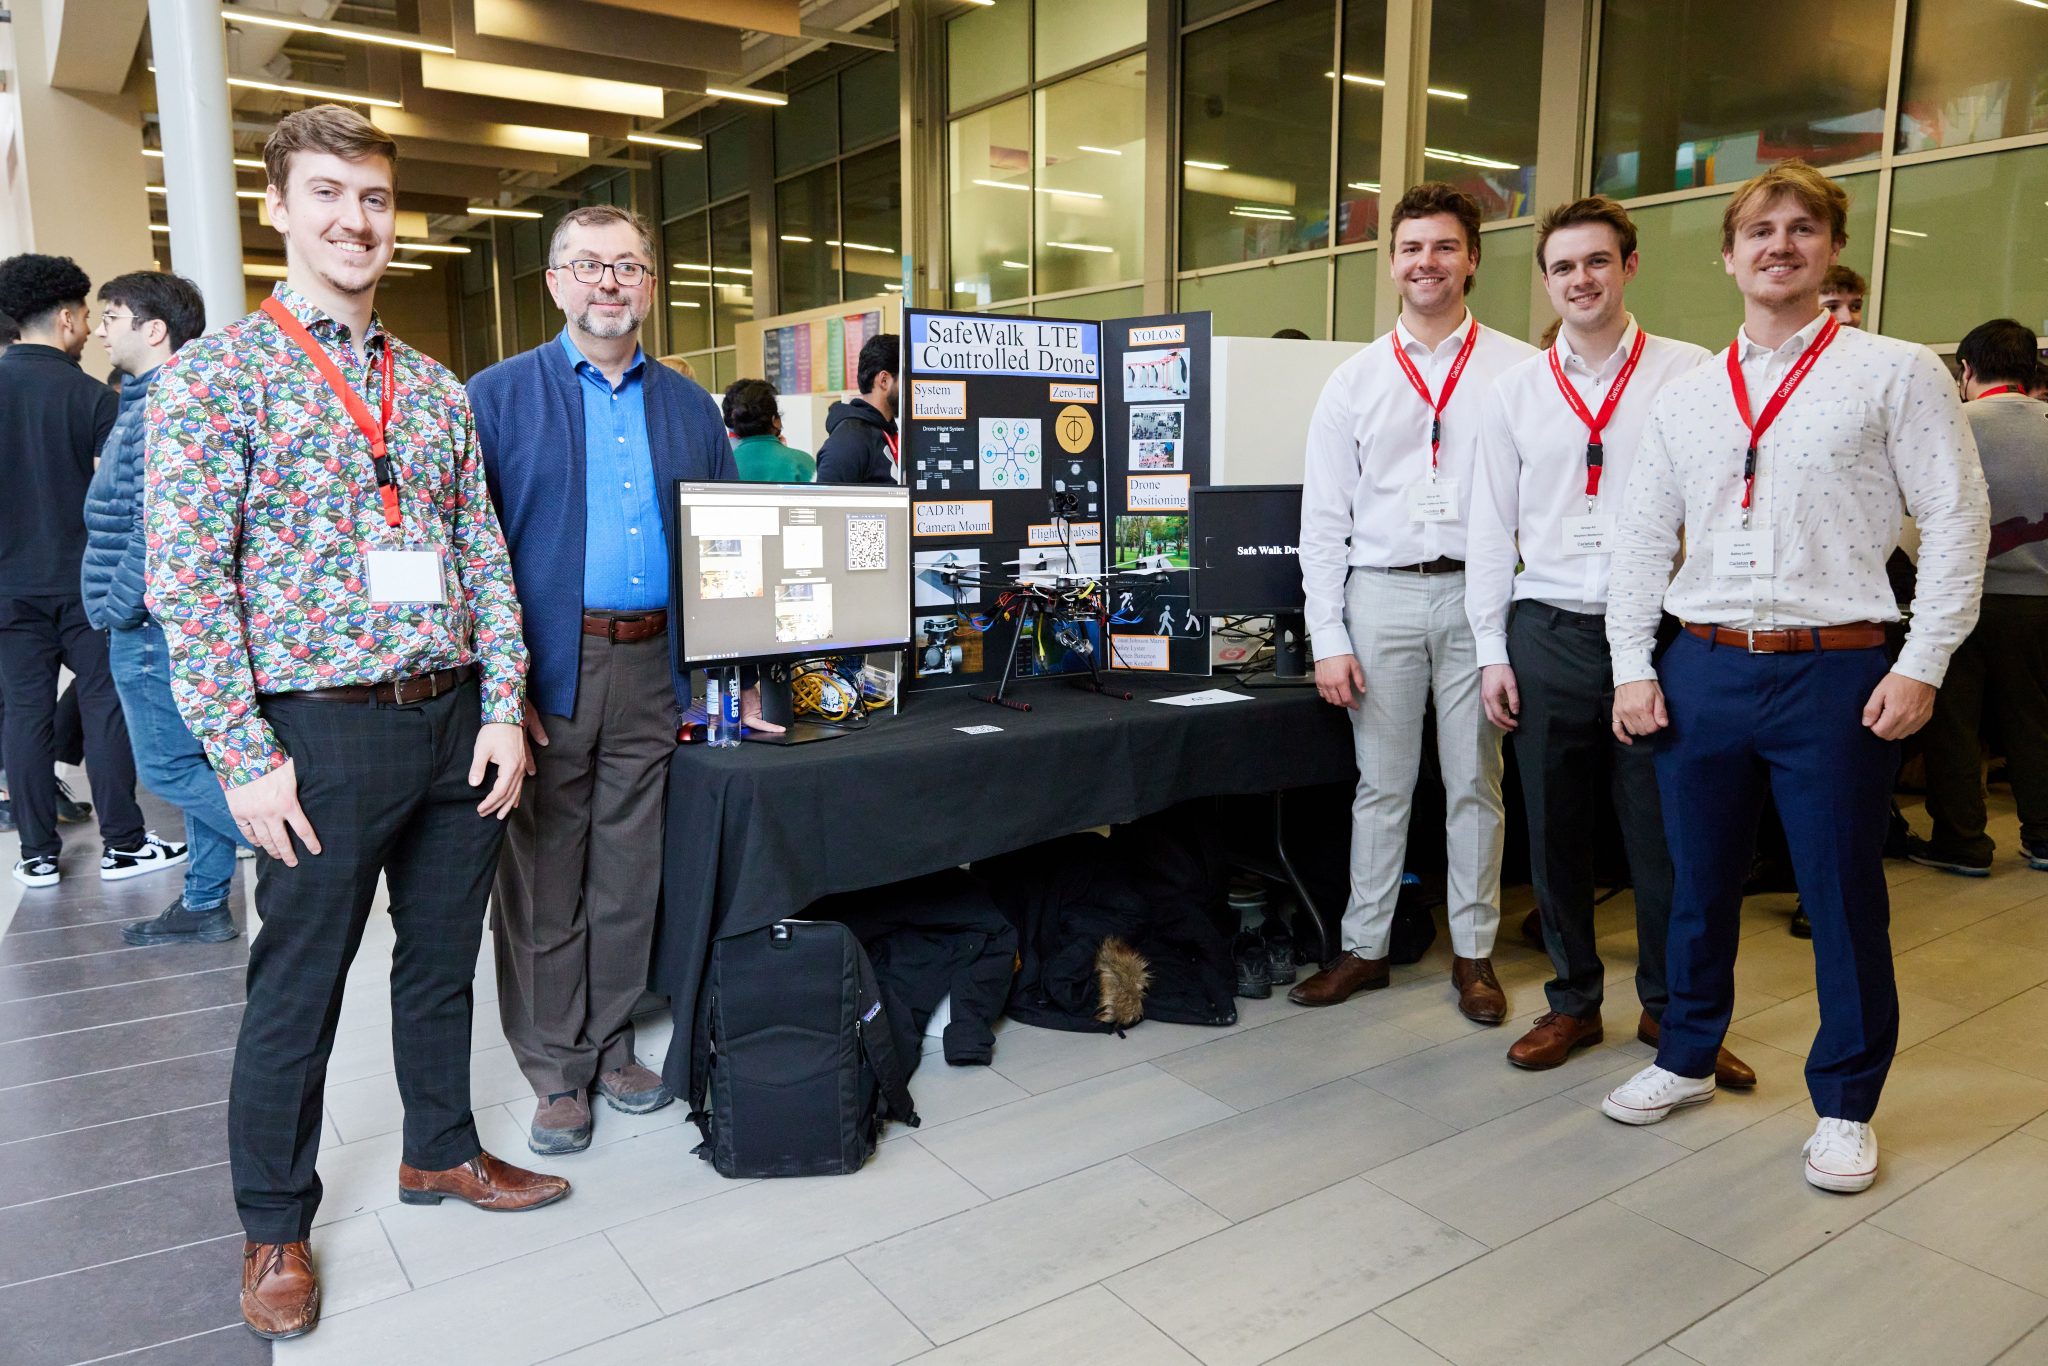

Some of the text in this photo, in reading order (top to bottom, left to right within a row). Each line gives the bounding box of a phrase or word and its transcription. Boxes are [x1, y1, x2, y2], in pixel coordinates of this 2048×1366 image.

[929, 320, 1078, 349] SafeWalk LTE
[1133, 328, 1181, 342] YOLOv8
[923, 346, 1029, 371] Controlled
[1038, 350, 1095, 374] Drone
[914, 383, 951, 396] System
[1608, 377, 1626, 401] Carleton
[1777, 369, 1802, 398] Carleton
[1052, 387, 1095, 399] Zero-Tier
[915, 403, 963, 416] Hardware
[1130, 479, 1161, 490] Drone
[1130, 494, 1186, 508] Positioning
[917, 503, 964, 517] CAD RPi
[917, 520, 990, 533] Camera Mount
[1031, 525, 1099, 542] Flight Aalysis
[1237, 546, 1257, 556] Safe
[1258, 545, 1283, 556] Walk
[728, 679, 739, 718] smart
